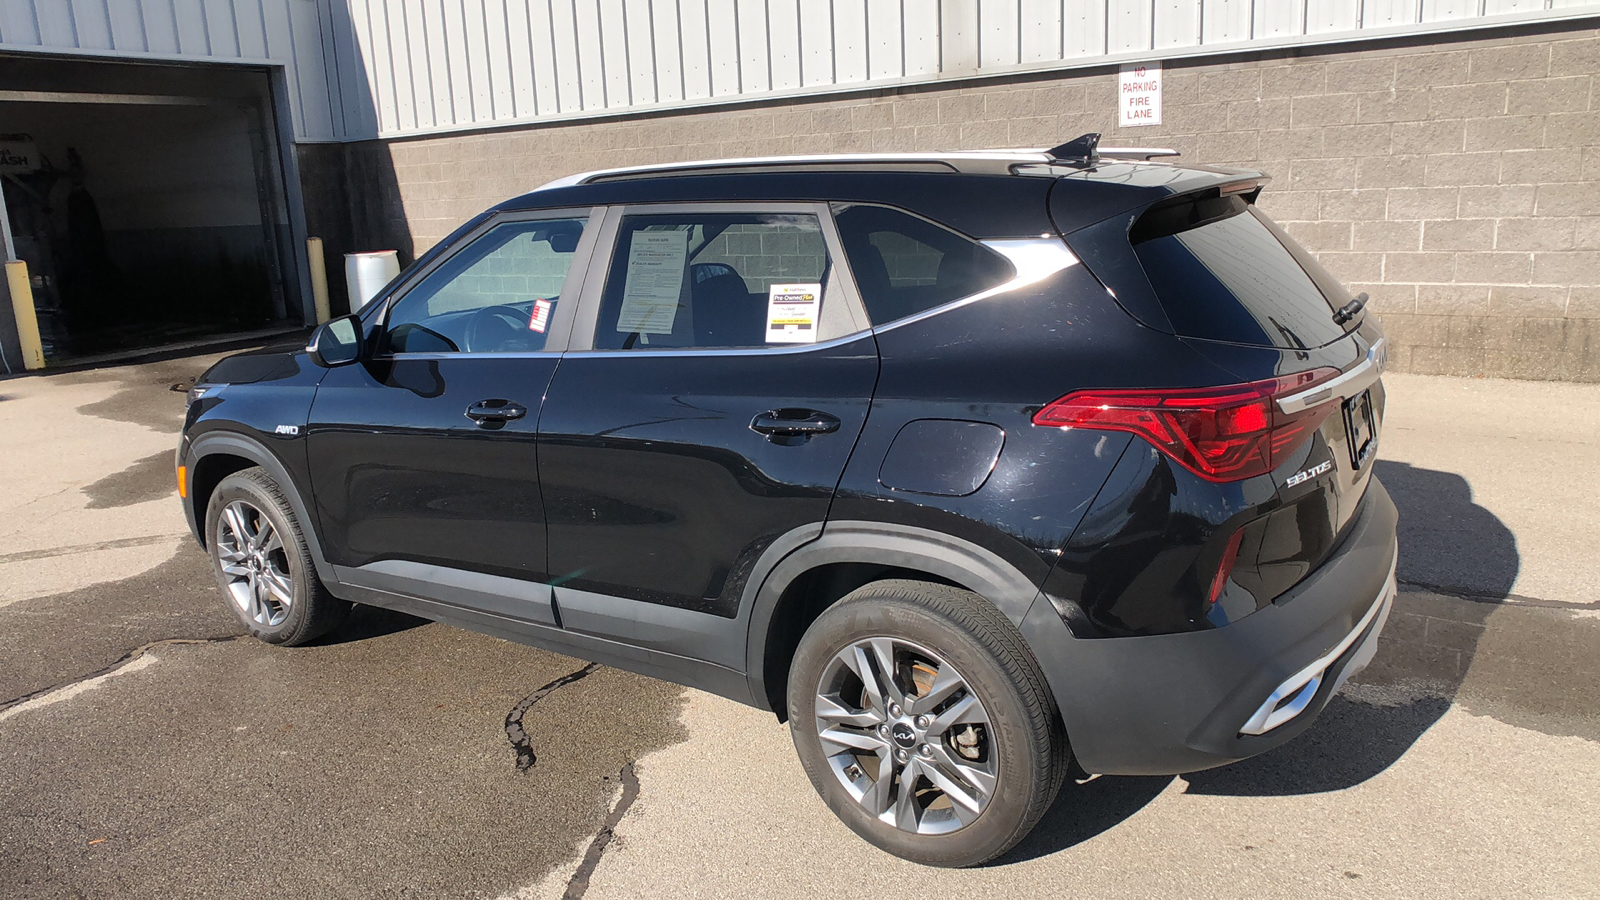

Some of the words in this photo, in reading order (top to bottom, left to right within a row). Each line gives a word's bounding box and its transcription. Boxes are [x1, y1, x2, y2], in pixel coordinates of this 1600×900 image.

[1134, 66, 1146, 78] NO
[1123, 80, 1158, 93] PARKING
[1129, 96, 1150, 107] FIRE
[1127, 108, 1153, 120] LANE
[275, 425, 299, 435] AWD
[1286, 460, 1331, 488] SELTOS
